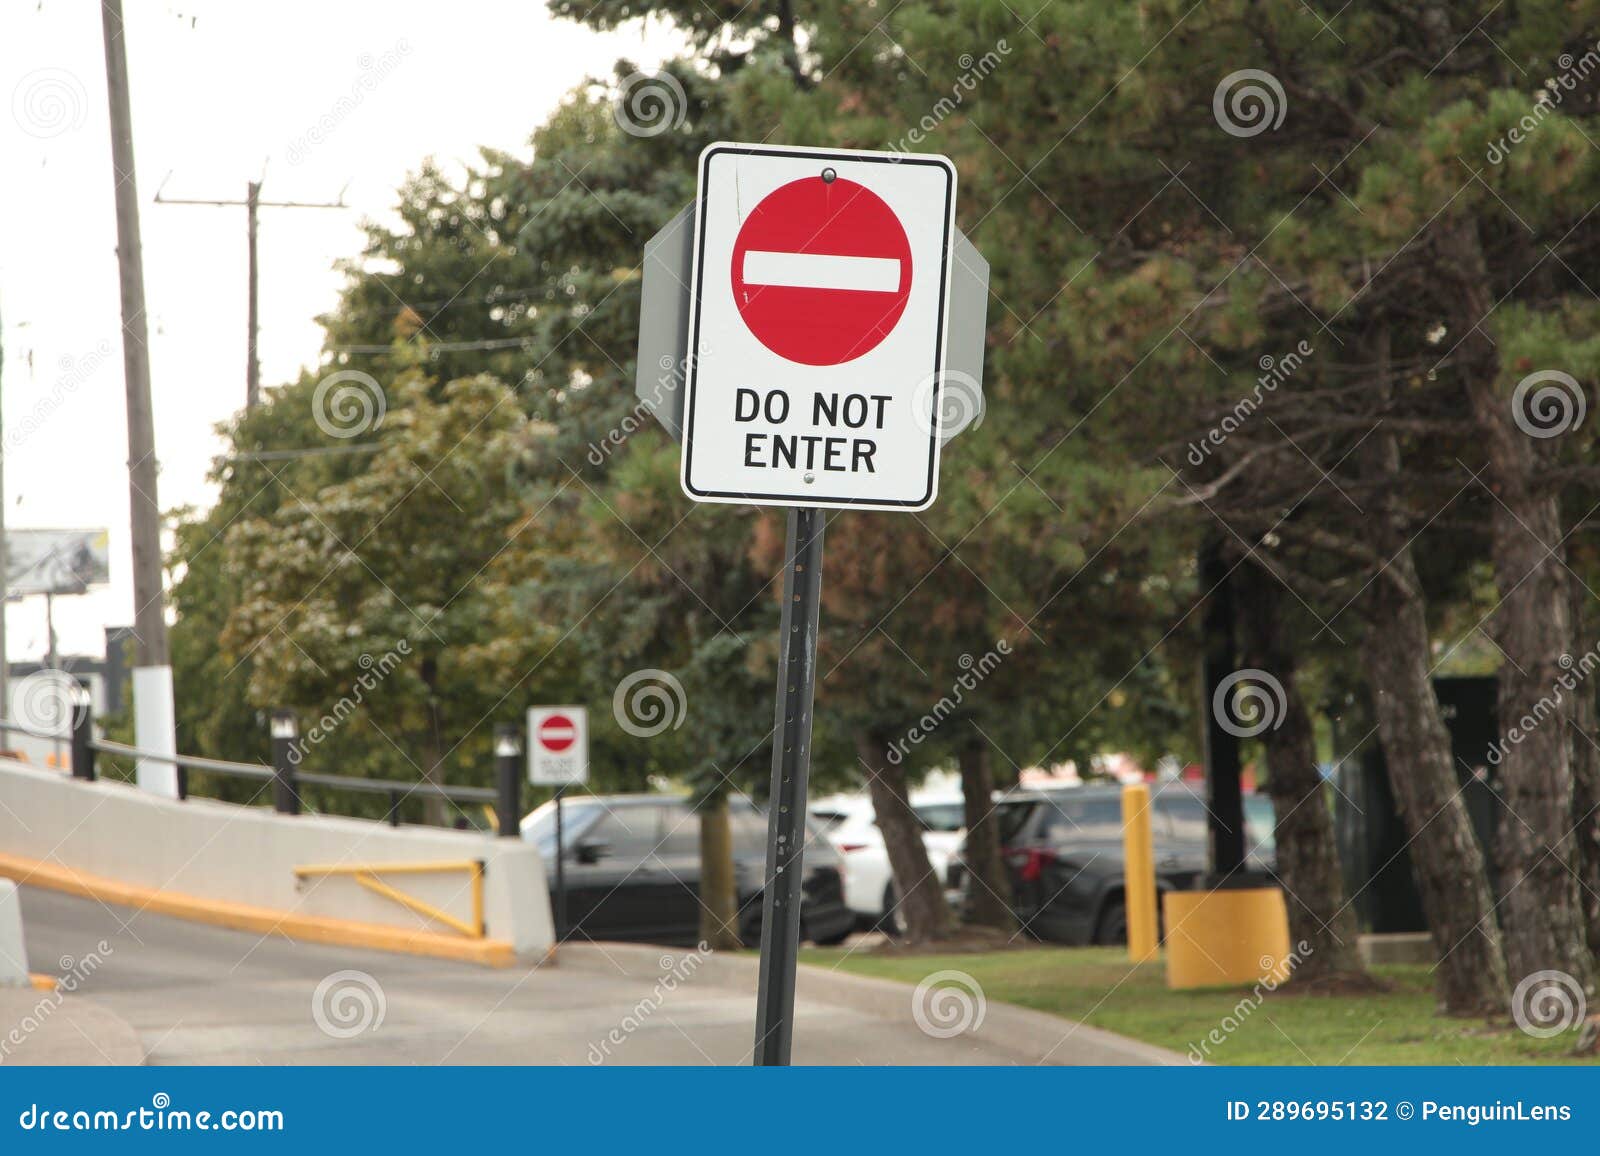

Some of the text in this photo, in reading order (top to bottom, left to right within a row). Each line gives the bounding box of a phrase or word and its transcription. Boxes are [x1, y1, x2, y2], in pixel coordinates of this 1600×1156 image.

[735, 388, 893, 429] DO NOT
[744, 433, 877, 473] ENTER
